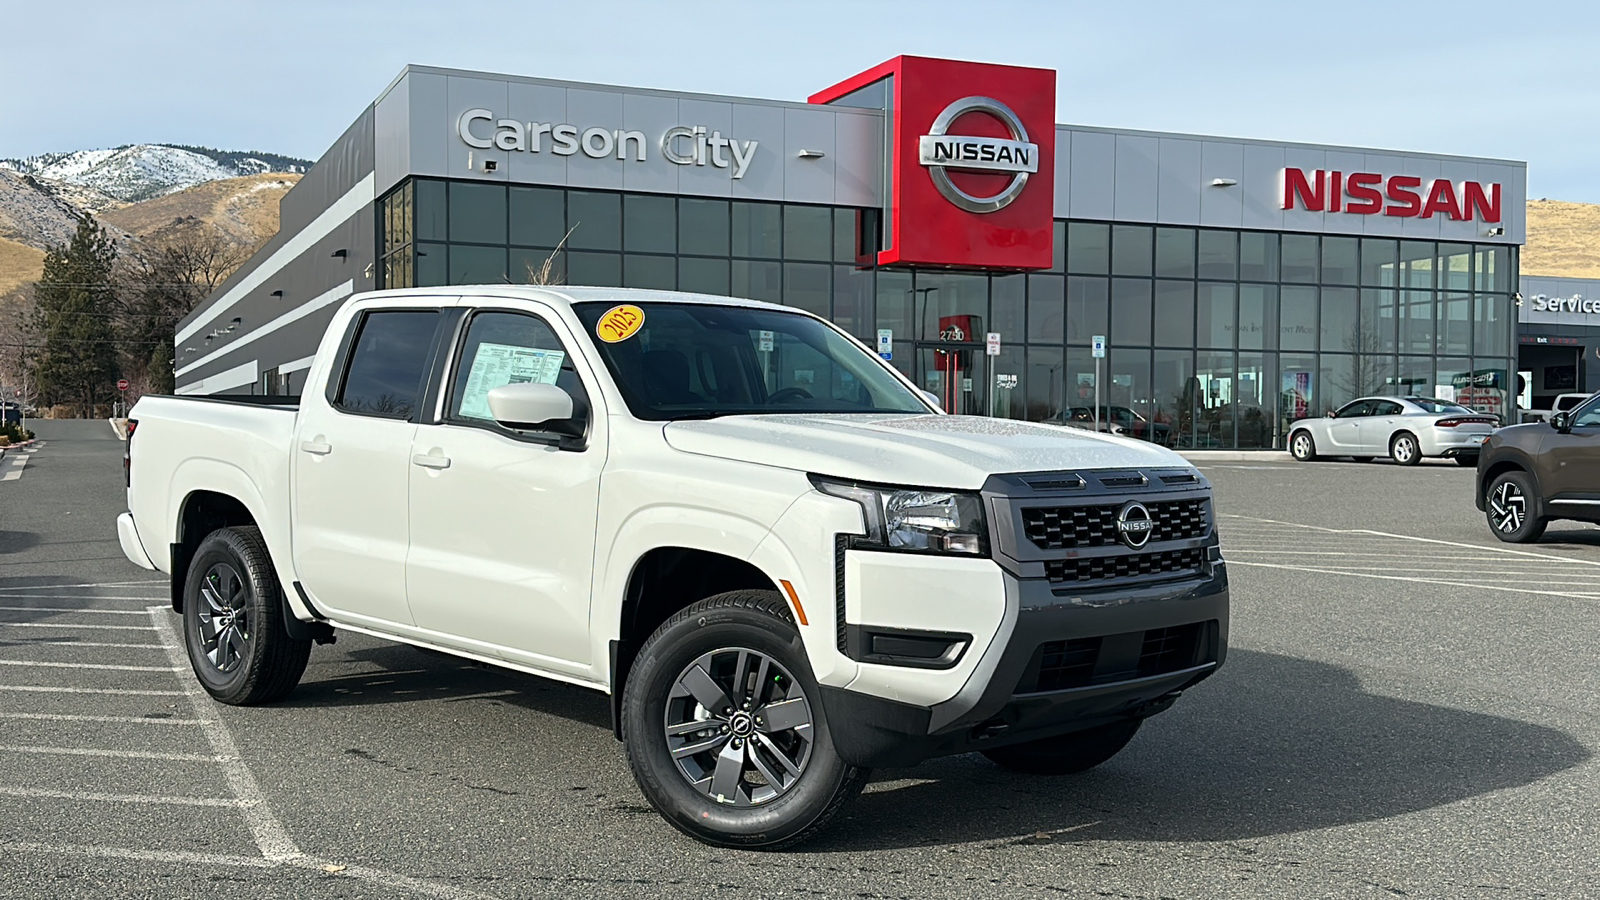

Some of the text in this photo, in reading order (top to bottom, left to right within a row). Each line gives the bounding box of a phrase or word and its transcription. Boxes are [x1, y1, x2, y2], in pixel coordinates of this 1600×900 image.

[457, 107, 759, 179] Carson City
[934, 141, 1029, 166] NISSAN
[1280, 167, 1502, 223] NISSAN
[1532, 293, 1600, 314] Service
[603, 307, 637, 338] 2025
[940, 330, 965, 341] 2750
[1121, 522, 1152, 531] NISSA
